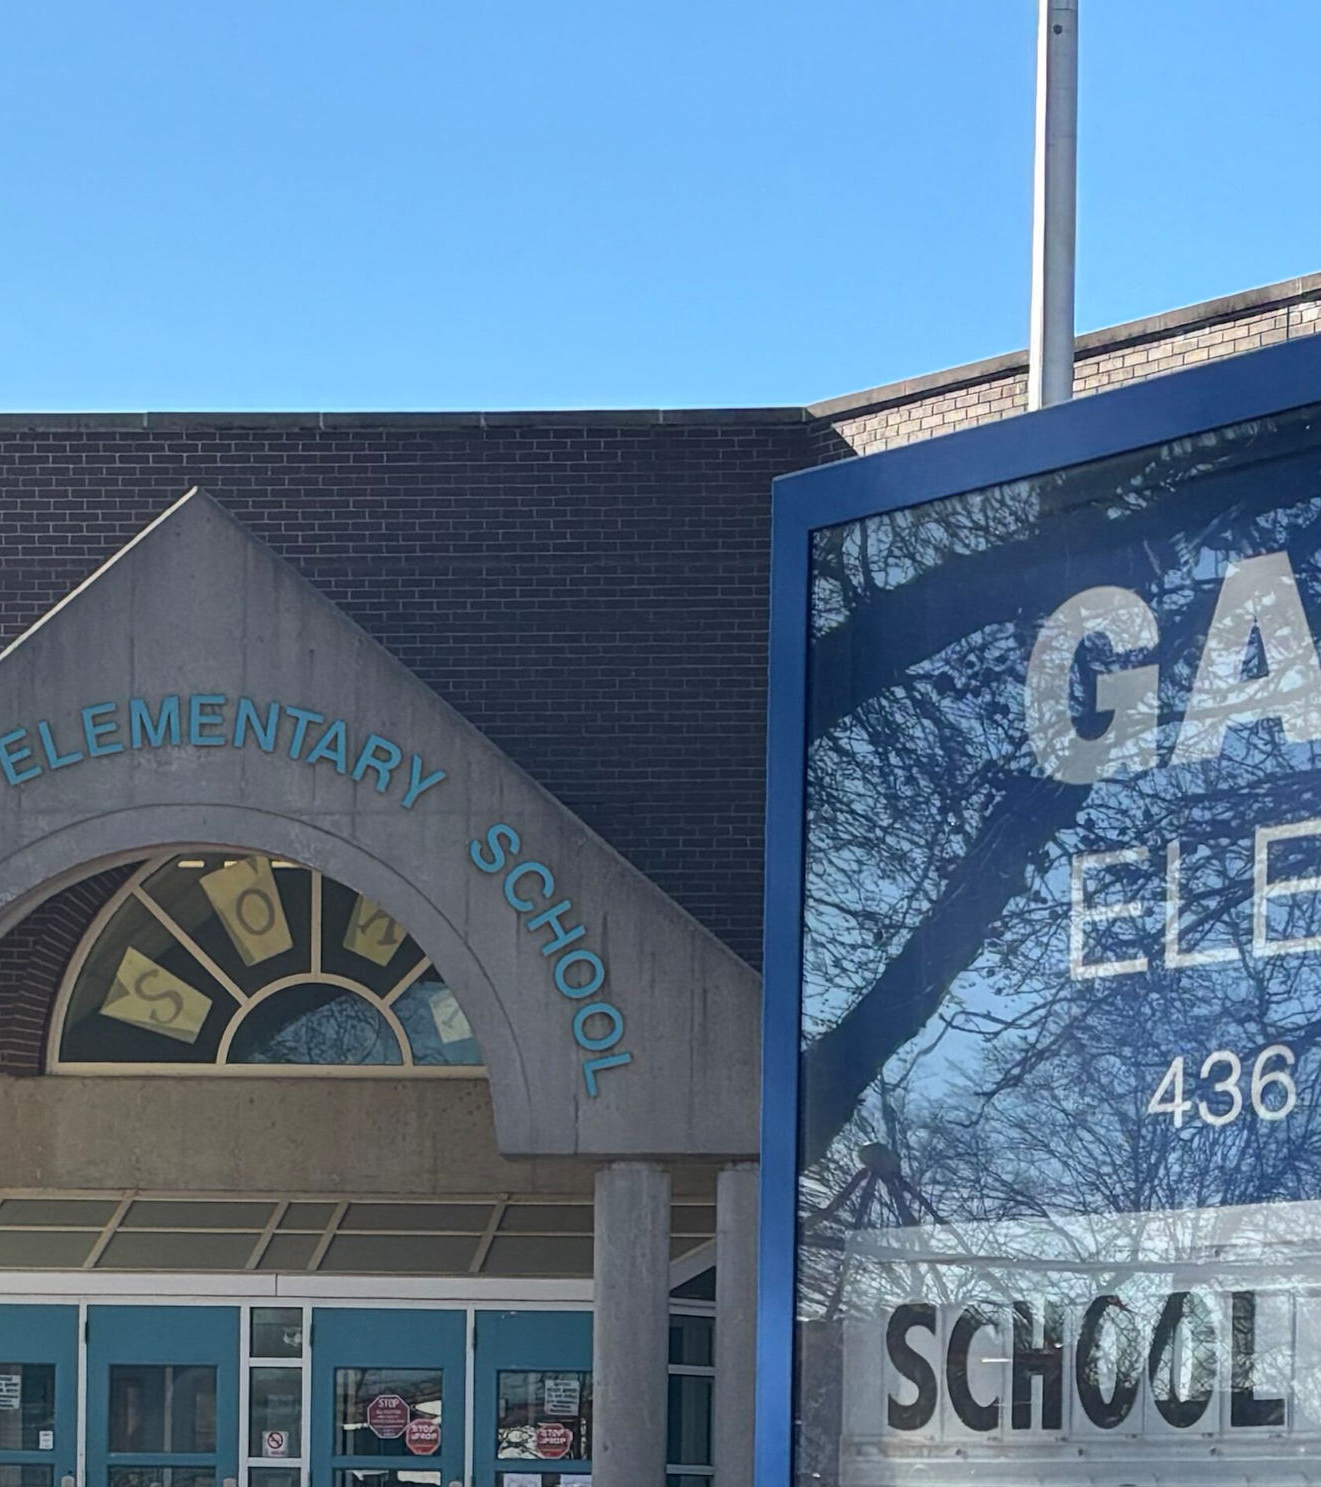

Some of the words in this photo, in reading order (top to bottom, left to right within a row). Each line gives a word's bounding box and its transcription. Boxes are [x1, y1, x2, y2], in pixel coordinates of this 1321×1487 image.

[468, 821, 635, 1098] SCHOOL
[1147, 1044, 1298, 1128] 436
[378, 1398, 399, 1408] STOP
[885, 1289, 1286, 1431] SCHOOL
